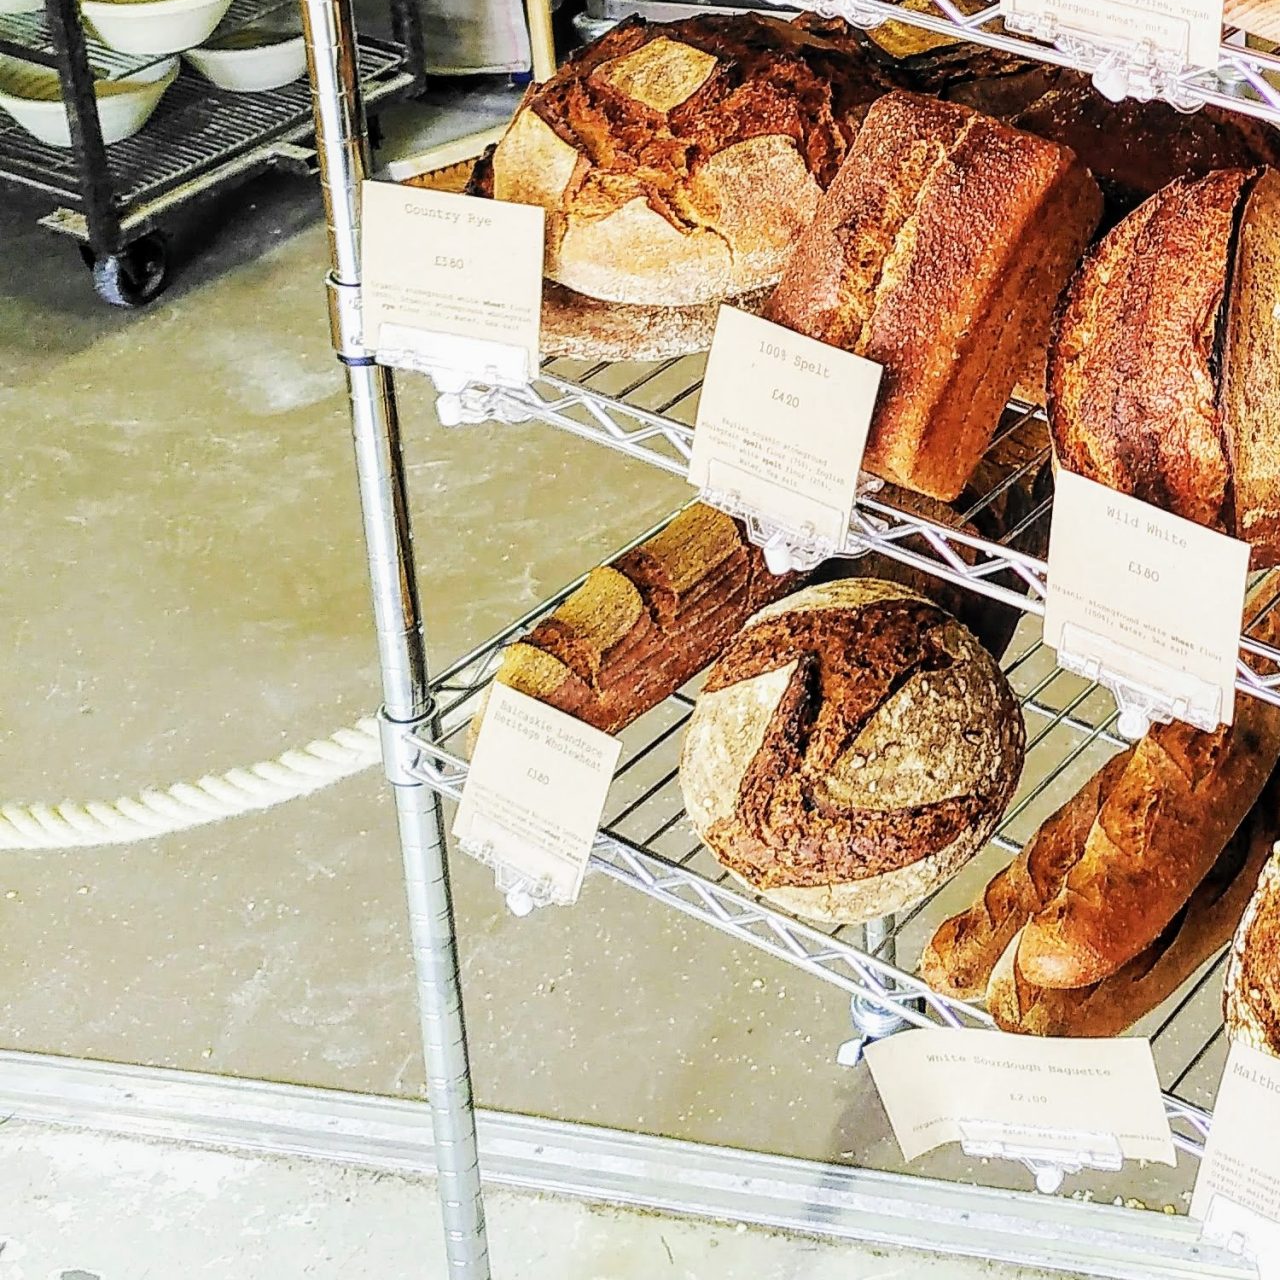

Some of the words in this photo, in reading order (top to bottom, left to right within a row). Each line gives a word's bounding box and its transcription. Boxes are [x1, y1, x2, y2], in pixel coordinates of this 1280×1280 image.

[403, 202, 462, 224] Country
[467, 212, 493, 227] Rye
[793, 354, 832, 379] Spelt
[1105, 505, 1139, 529] Wild
[1146, 521, 1188, 549] White
[925, 1052, 967, 1065] White
[972, 1054, 1042, 1073] Sourdough
[1047, 1064, 1112, 1078] Baguette
